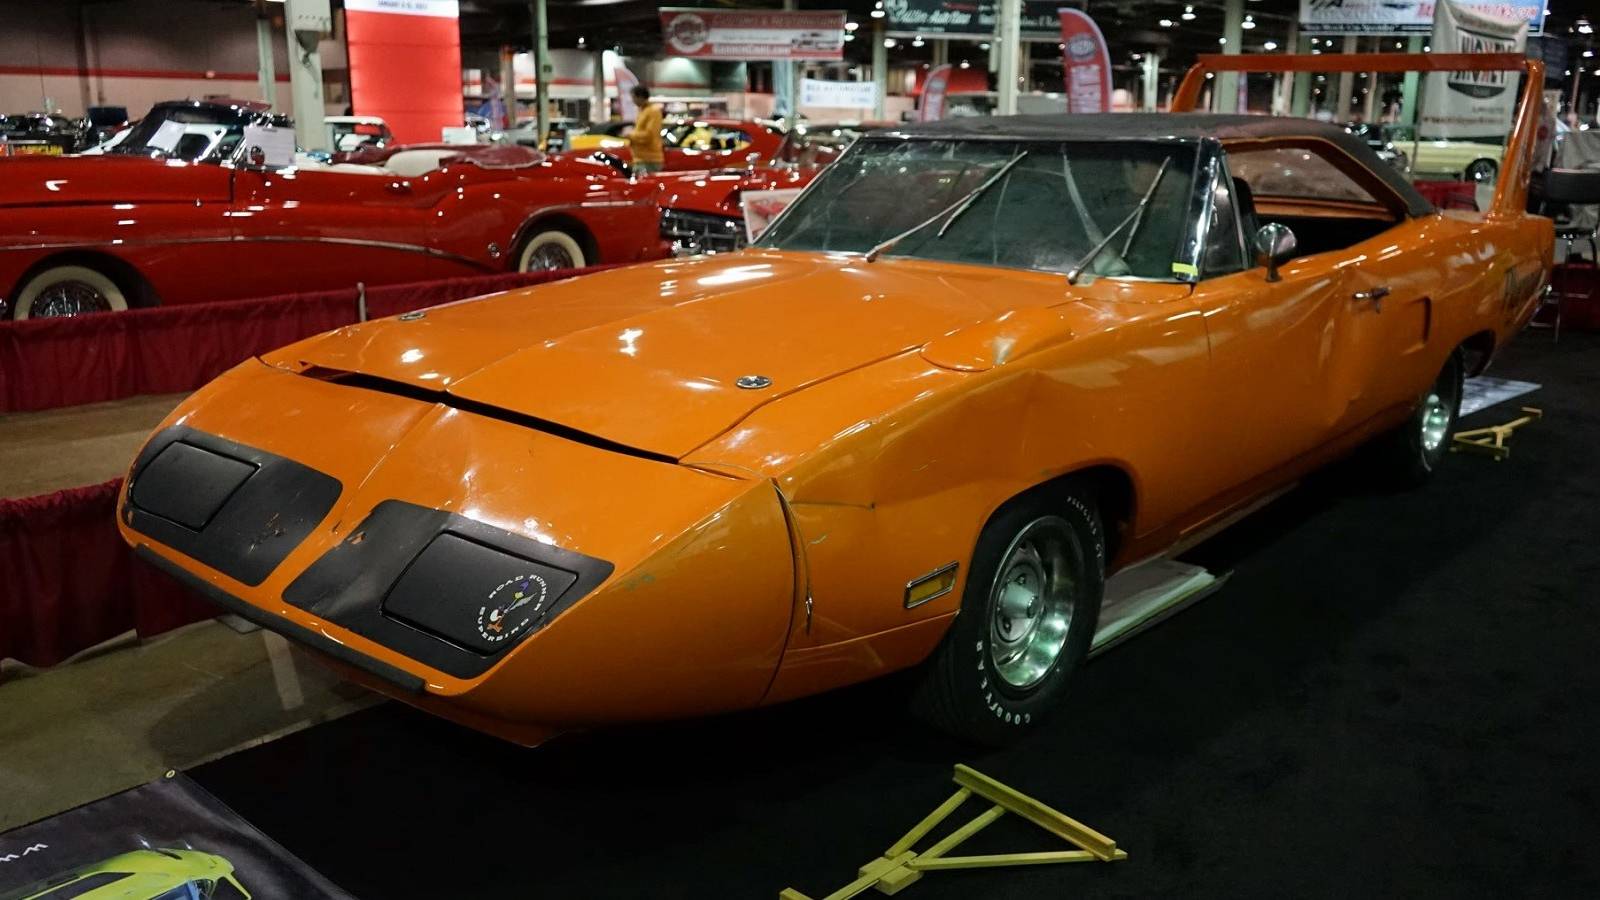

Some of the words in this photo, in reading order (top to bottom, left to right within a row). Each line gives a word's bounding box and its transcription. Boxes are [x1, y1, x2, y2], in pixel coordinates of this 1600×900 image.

[488, 575, 524, 600] ROAD
[529, 574, 547, 611] RUNNER
[477, 606, 529, 642] SUPERBIRD
[975, 640, 1031, 725] GOODYEAR
